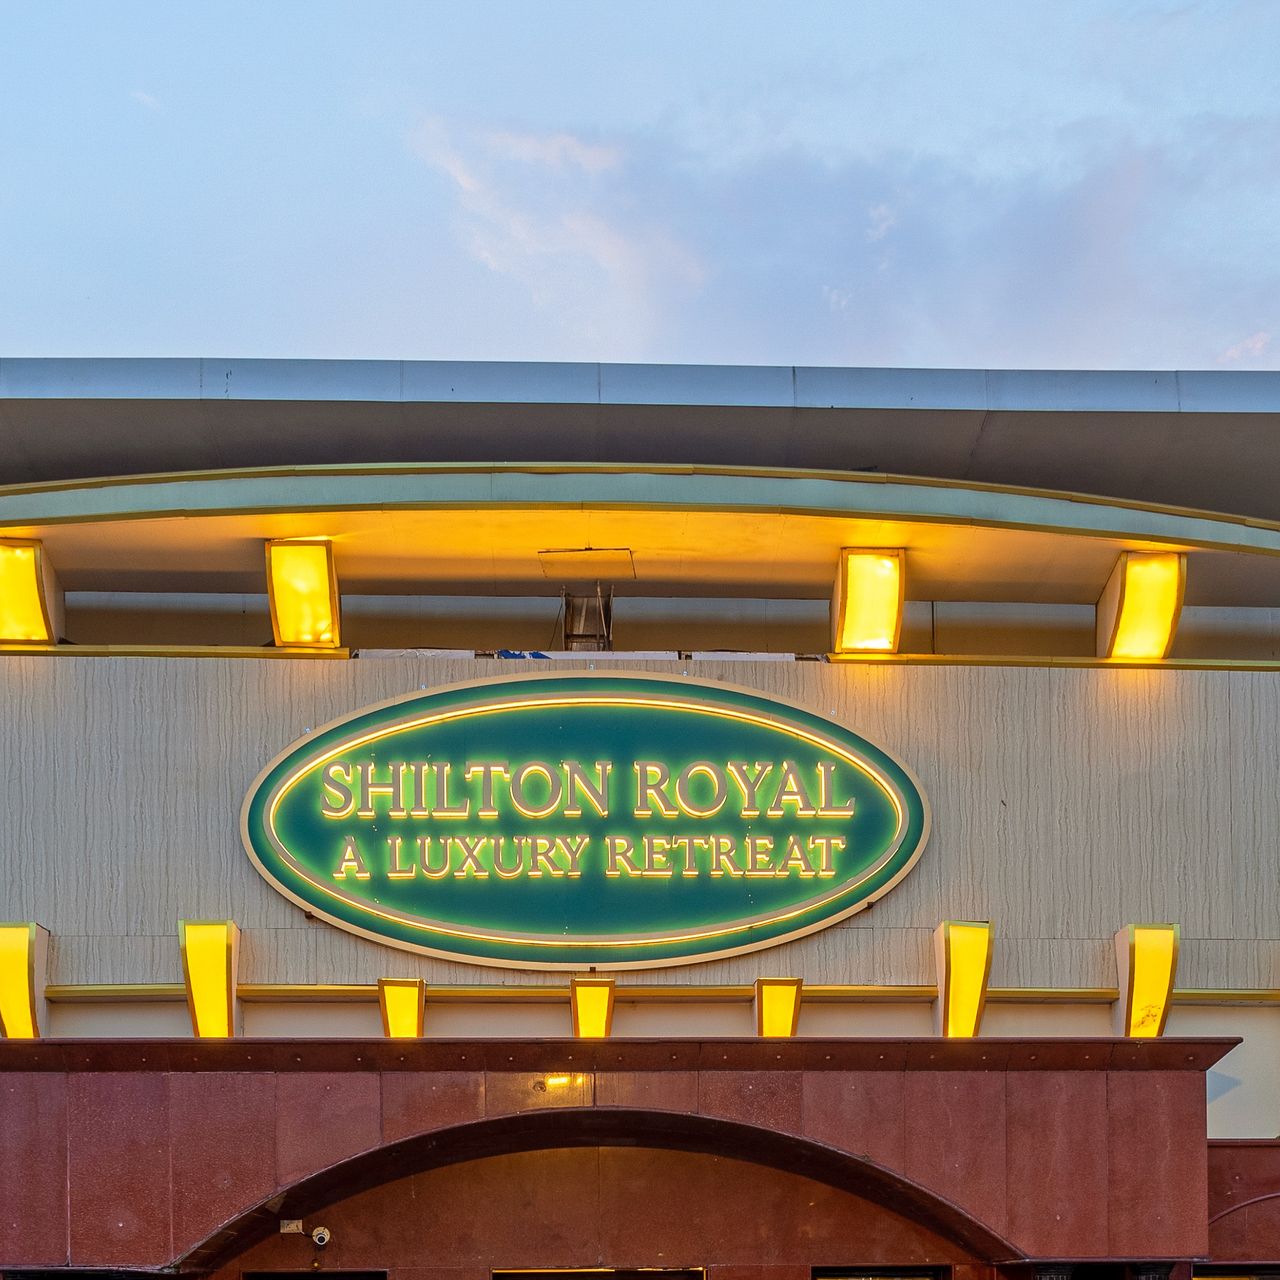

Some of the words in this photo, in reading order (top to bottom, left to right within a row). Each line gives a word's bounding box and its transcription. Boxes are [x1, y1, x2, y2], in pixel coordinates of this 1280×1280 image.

[321, 760, 613, 819] SHILTON
[633, 760, 856, 818] ROYAL
[332, 836, 371, 879] A
[386, 836, 590, 879] LUXURY
[605, 835, 847, 878] RETREAT
